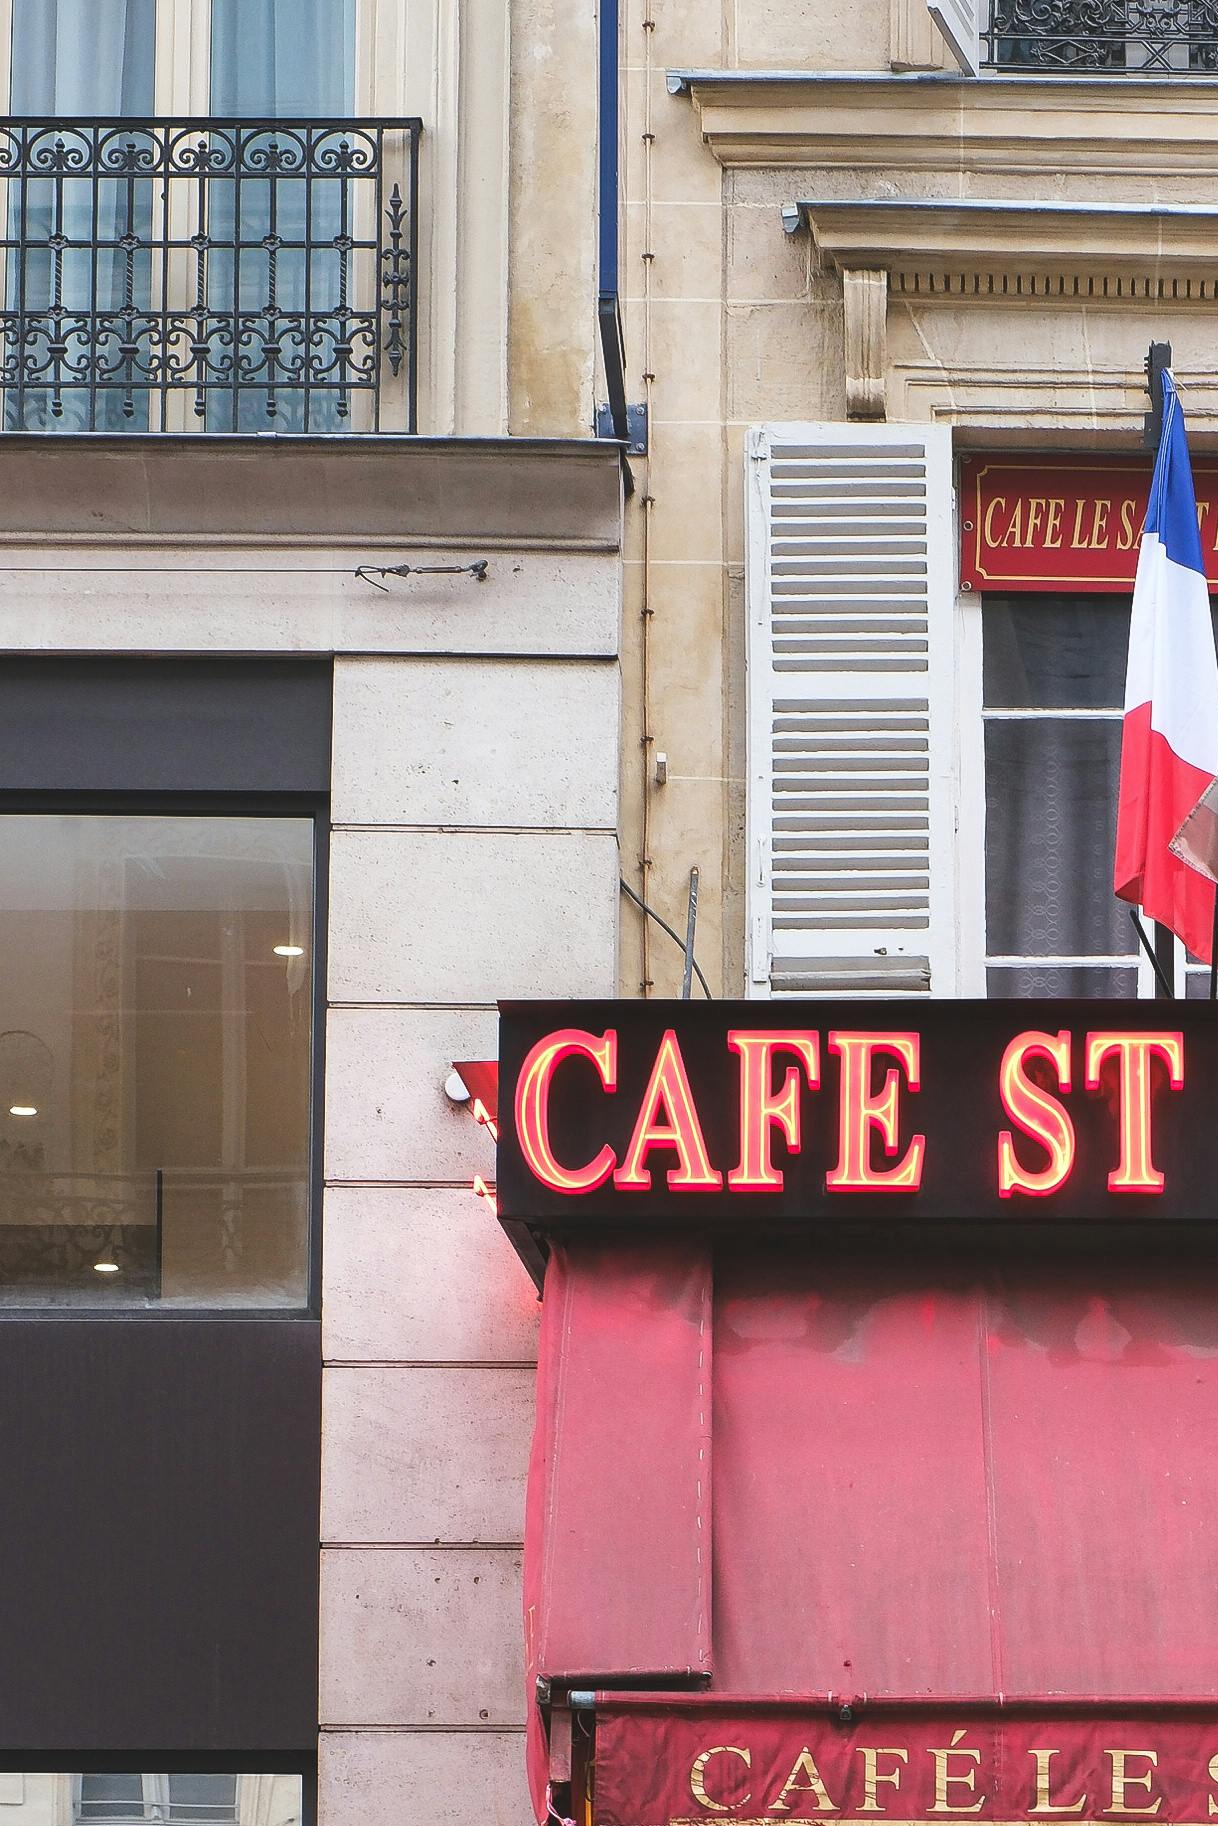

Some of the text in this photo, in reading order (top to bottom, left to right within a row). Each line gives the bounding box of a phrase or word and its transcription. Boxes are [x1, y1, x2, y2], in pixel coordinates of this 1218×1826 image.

[984, 497, 1065, 549] CAFE
[1070, 499, 1111, 549] LE
[515, 1029, 925, 1195] CAFE
[998, 1030, 1184, 1198] ST
[690, 1729, 984, 1814] CAFÉ
[1027, 1748, 1162, 1815] LE
